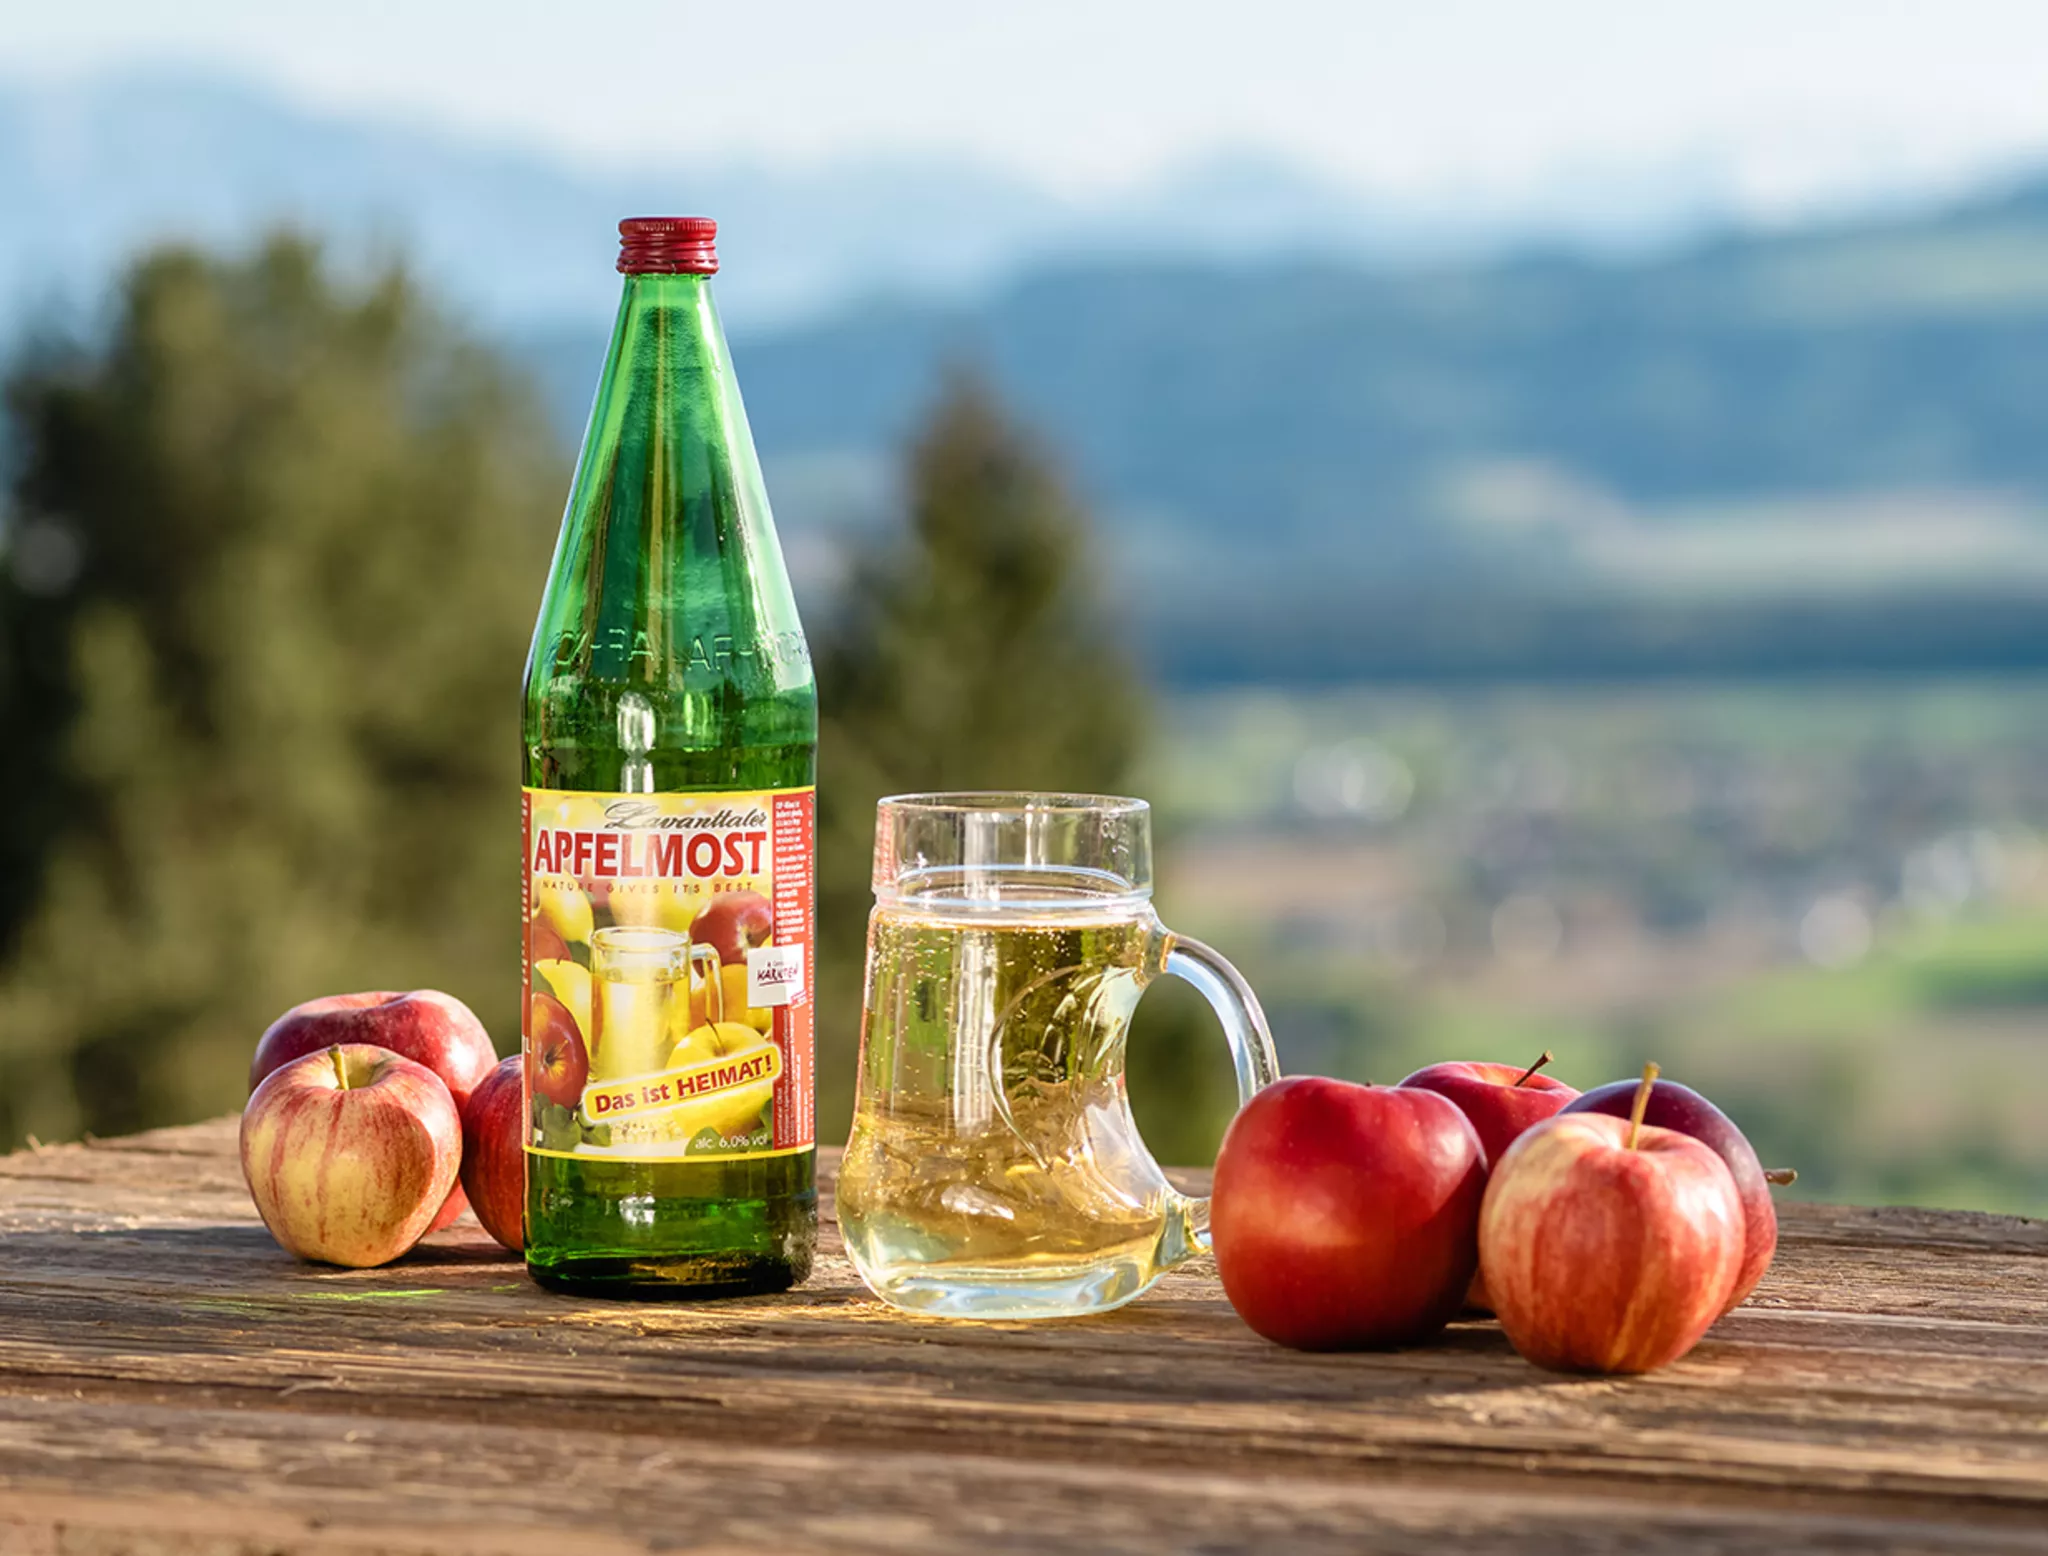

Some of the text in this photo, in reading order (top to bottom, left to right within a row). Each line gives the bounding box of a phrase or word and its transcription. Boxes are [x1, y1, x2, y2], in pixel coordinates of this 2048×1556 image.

[604, 802, 767, 830] Lavanttaler
[534, 829, 767, 877] APFELMOST
[543, 881, 752, 894] NATURE GIVES ITS BEST
[595, 1054, 772, 1113] Das ist HEIMAT!
